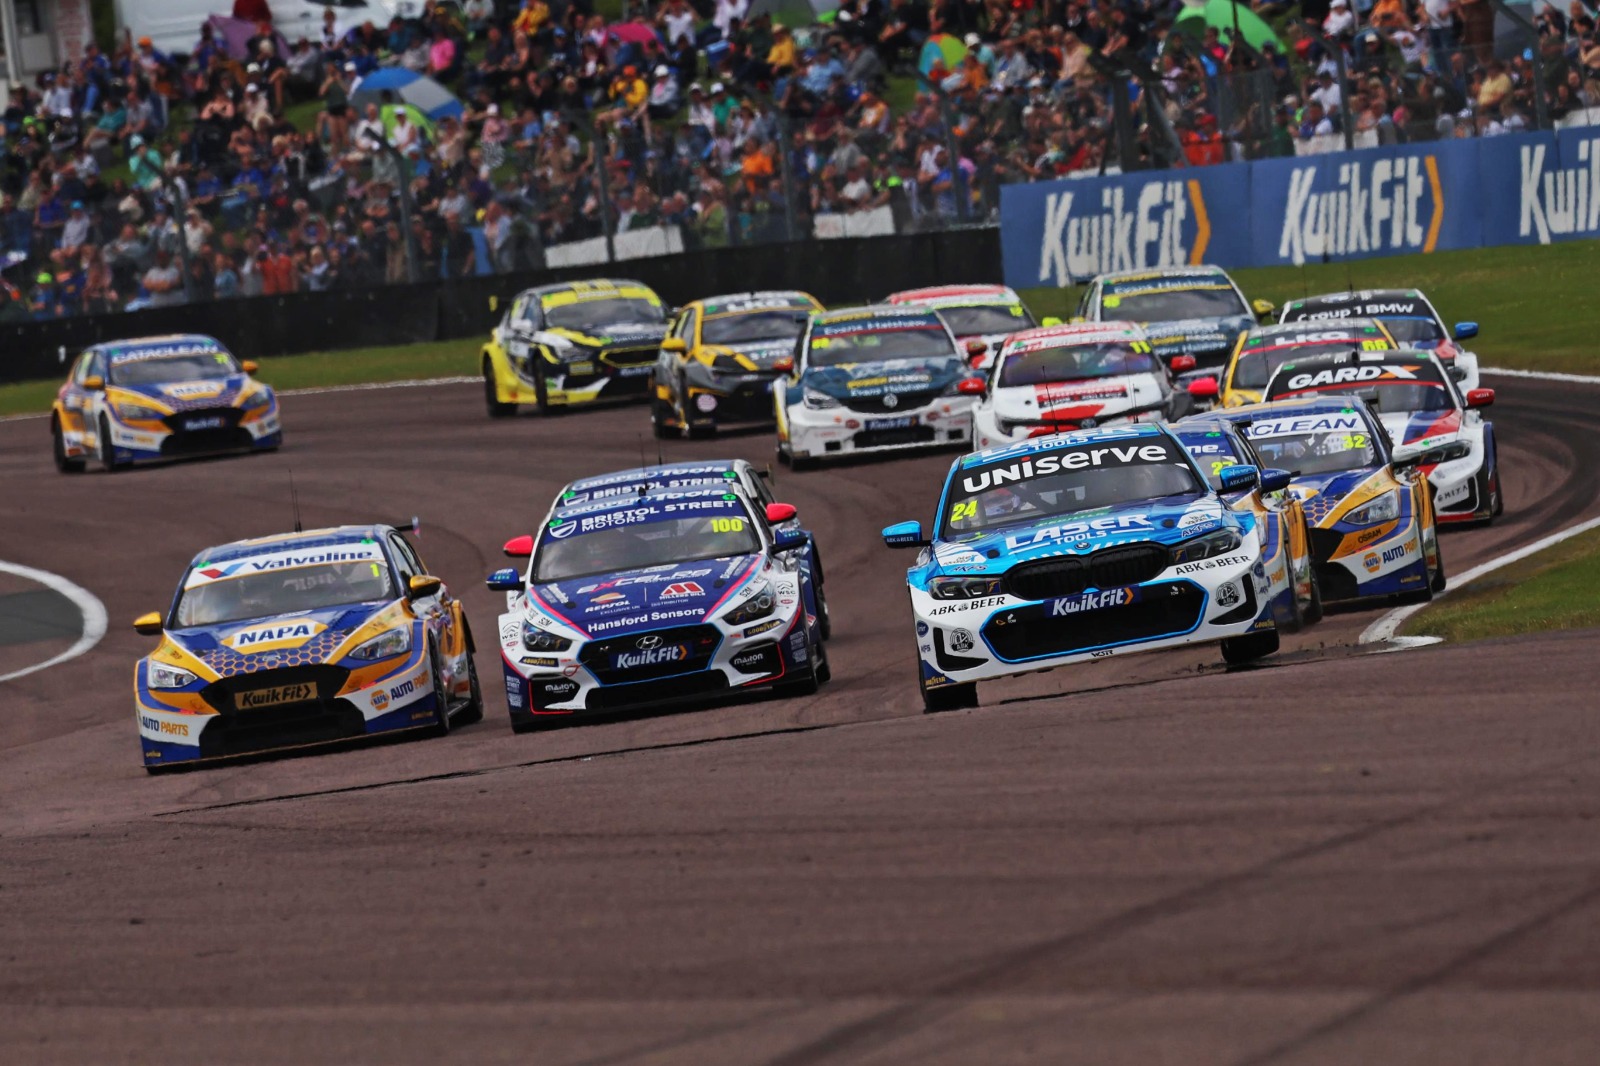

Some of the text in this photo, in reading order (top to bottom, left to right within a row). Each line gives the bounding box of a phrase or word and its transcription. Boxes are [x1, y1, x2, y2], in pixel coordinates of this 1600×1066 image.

[1366, 303, 1414, 314] BMW
[1130, 341, 1151, 354] 11
[1032, 436, 1089, 450] TOOLS
[1342, 435, 1366, 449] 32
[581, 501, 736, 526] BRISTOL STREET
[950, 500, 978, 522] 24
[581, 515, 646, 532] MOTORS
[711, 519, 744, 533] 100
[1005, 514, 1152, 549] LASER
[1053, 531, 1107, 545] TOOLS
[1358, 528, 1382, 543] OSRAM
[252, 551, 373, 570] Valvoline
[1382, 546, 1405, 564] AUTO
[370, 563, 380, 577] 1
[1176, 555, 1252, 575] ABK BEER
[585, 600, 630, 613] REPSOL
[928, 596, 1006, 616] ABK BEER
[588, 607, 706, 633] Hansford Sensors
[239, 625, 310, 645] NAPA
[390, 680, 414, 700] AUTO
[142, 716, 189, 736] AUTO PARTS
